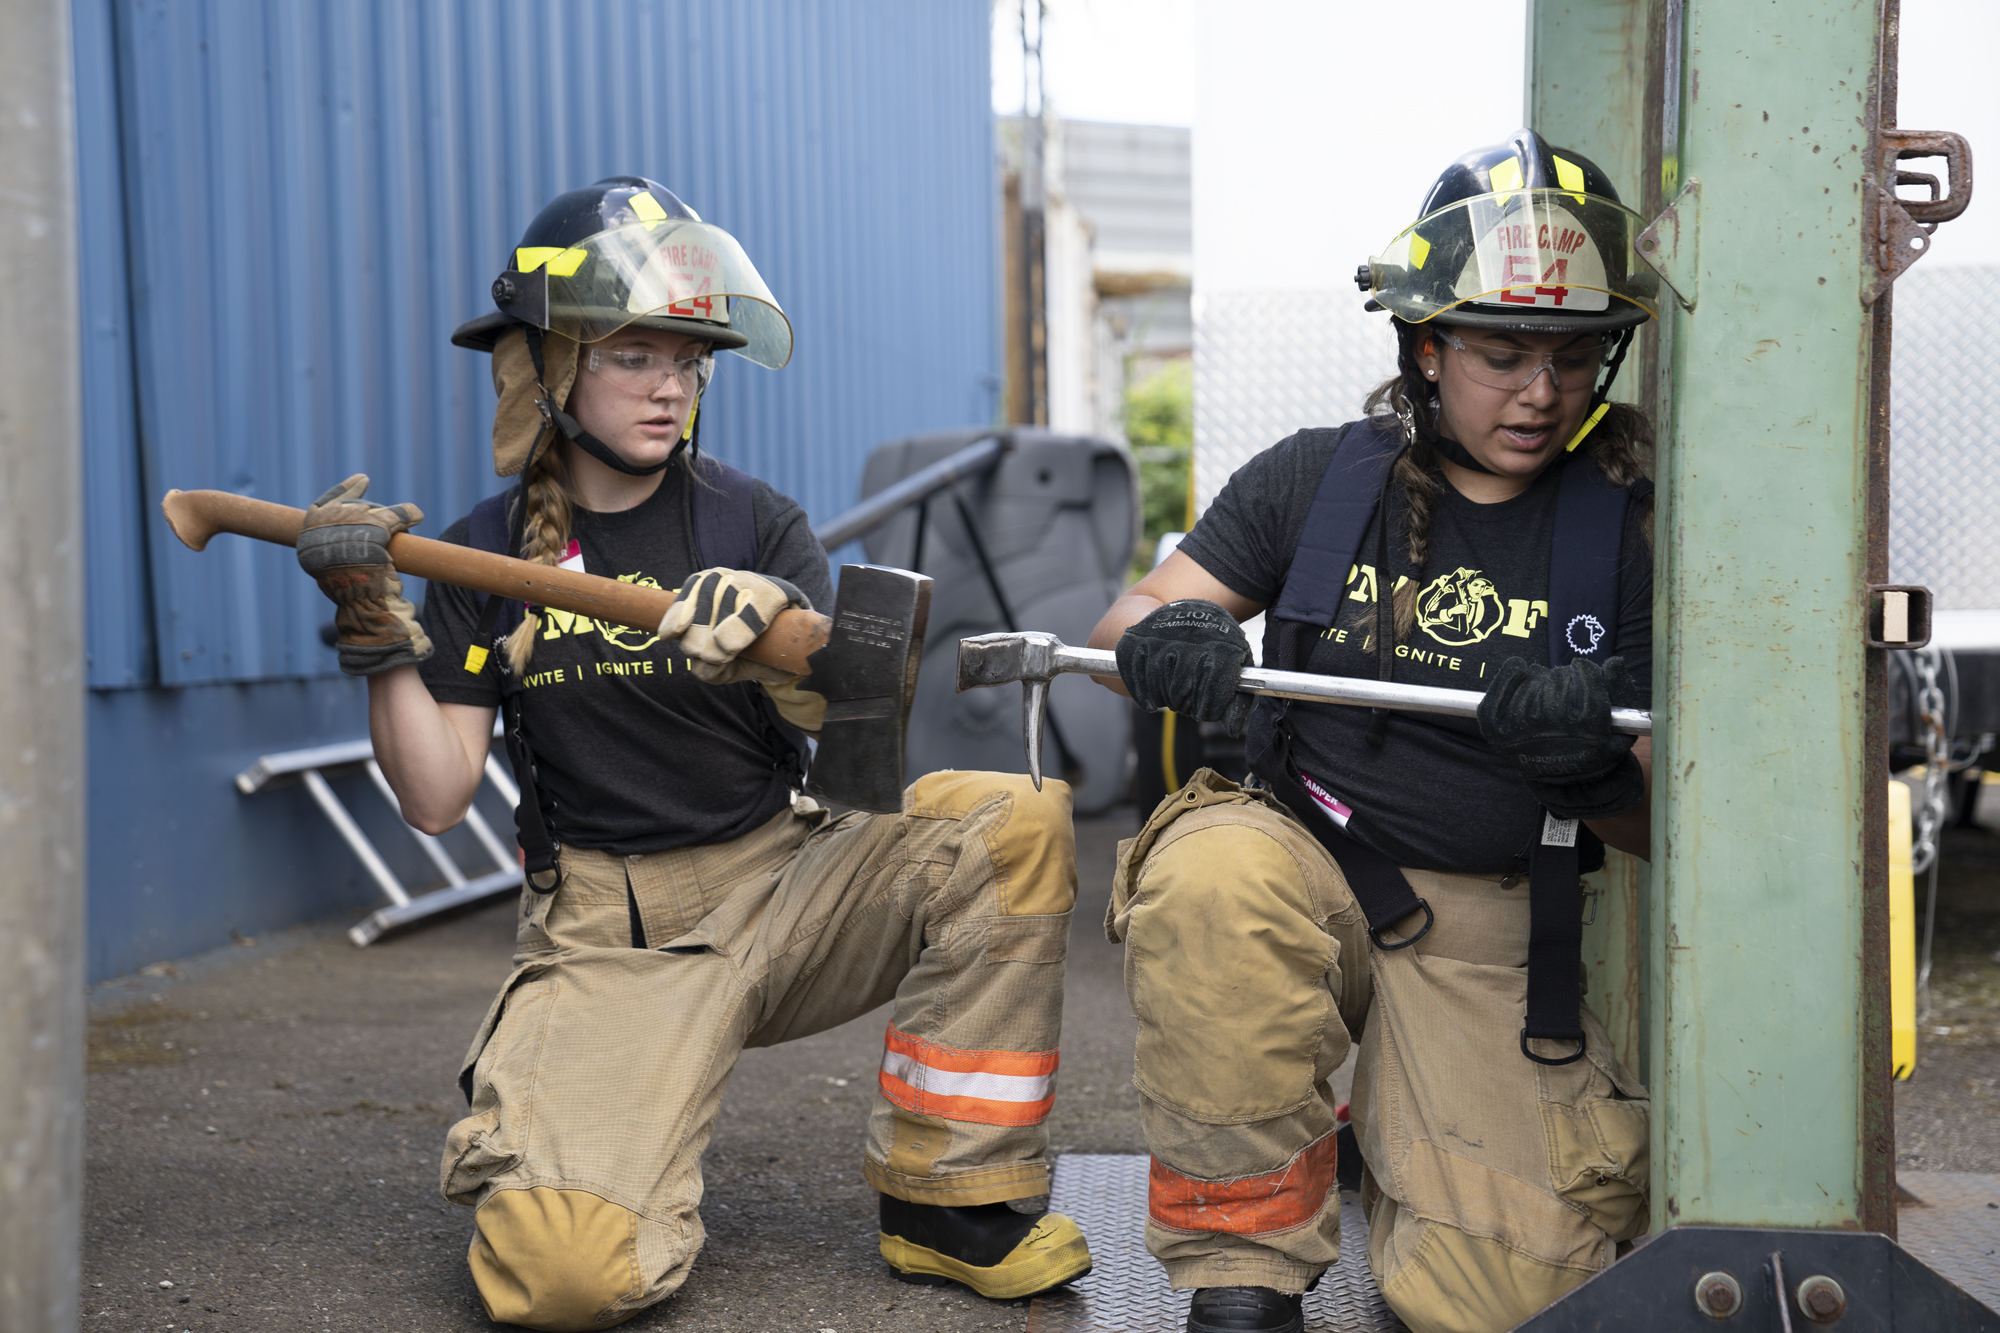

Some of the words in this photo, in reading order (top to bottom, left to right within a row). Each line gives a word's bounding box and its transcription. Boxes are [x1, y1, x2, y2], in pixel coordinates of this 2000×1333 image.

[1497, 224, 1532, 251] FIRE
[1538, 224, 1586, 255] CAMP
[660, 245, 688, 268] FIRE
[691, 245, 719, 273] CAMP
[668, 273, 713, 317] E4
[1500, 255, 1568, 306] E4
[1152, 620, 1220, 629] COMMANDER
[1175, 610, 1219, 622] LION
[1395, 645, 1462, 671] GNITE
[522, 669, 565, 690] NVITE
[596, 661, 654, 676] IGNITE
[1301, 775, 1339, 806] CAMPER
